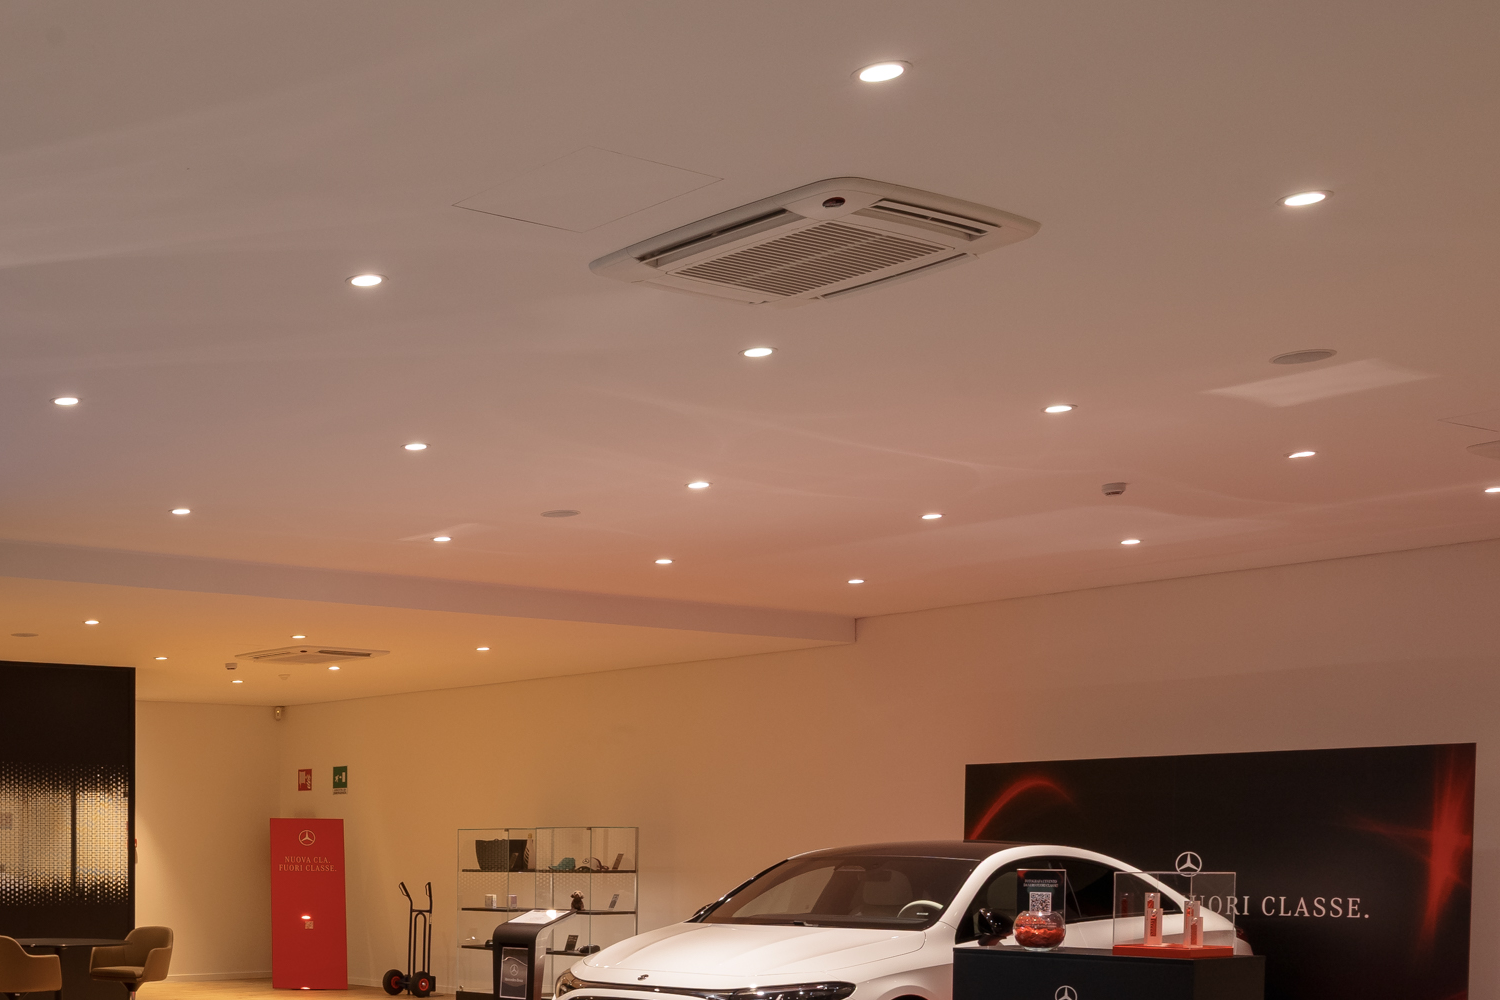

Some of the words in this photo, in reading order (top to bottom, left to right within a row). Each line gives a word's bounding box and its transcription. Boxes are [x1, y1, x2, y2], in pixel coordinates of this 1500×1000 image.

[284, 856, 311, 864] NUOVA
[313, 856, 331, 864] CLA.
[278, 864, 303, 872] FUORI
[305, 864, 337, 872] CLASSE.
[1182, 894, 1250, 916] ORI
[1261, 896, 1370, 919] CLASSE.
